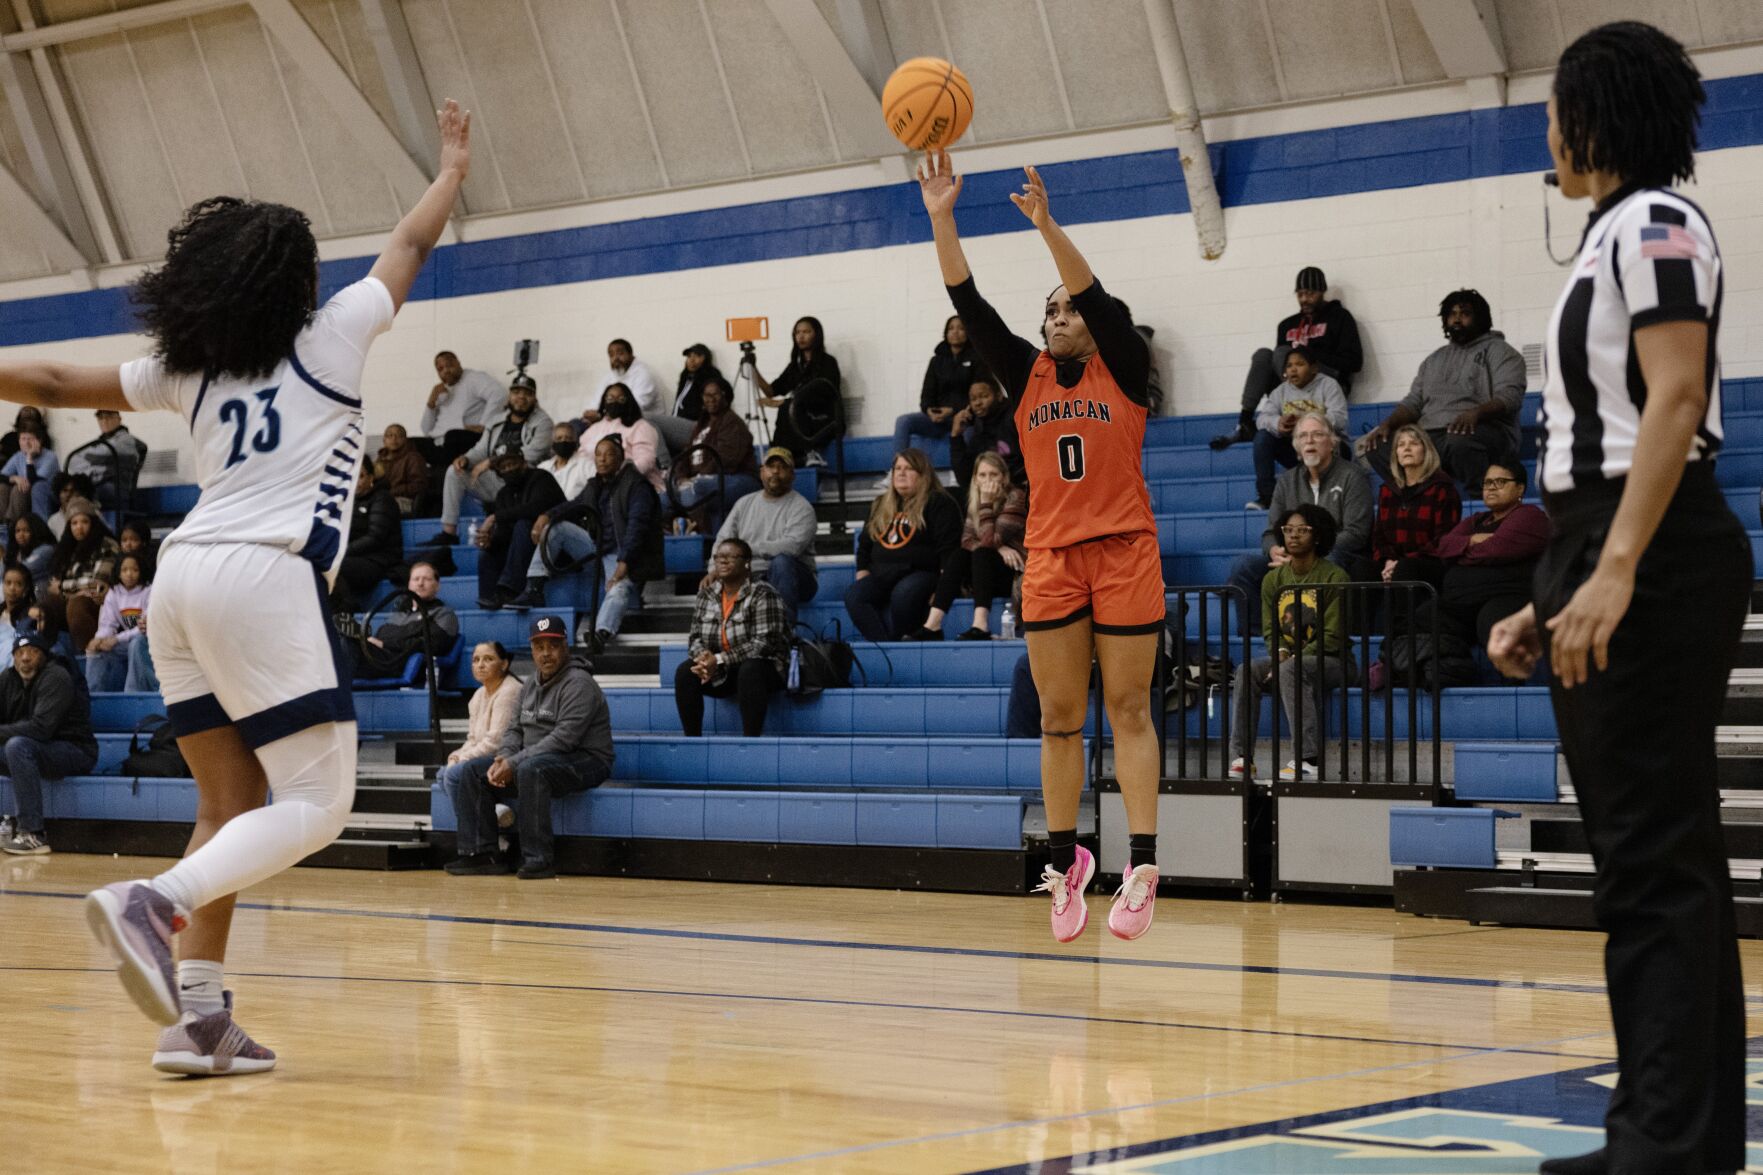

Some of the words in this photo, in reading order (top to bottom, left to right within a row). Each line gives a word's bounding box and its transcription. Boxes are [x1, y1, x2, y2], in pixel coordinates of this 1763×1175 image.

[219, 384, 281, 469] 23
[1028, 399, 1112, 431] MONACAN
[1056, 433, 1086, 482] 0
